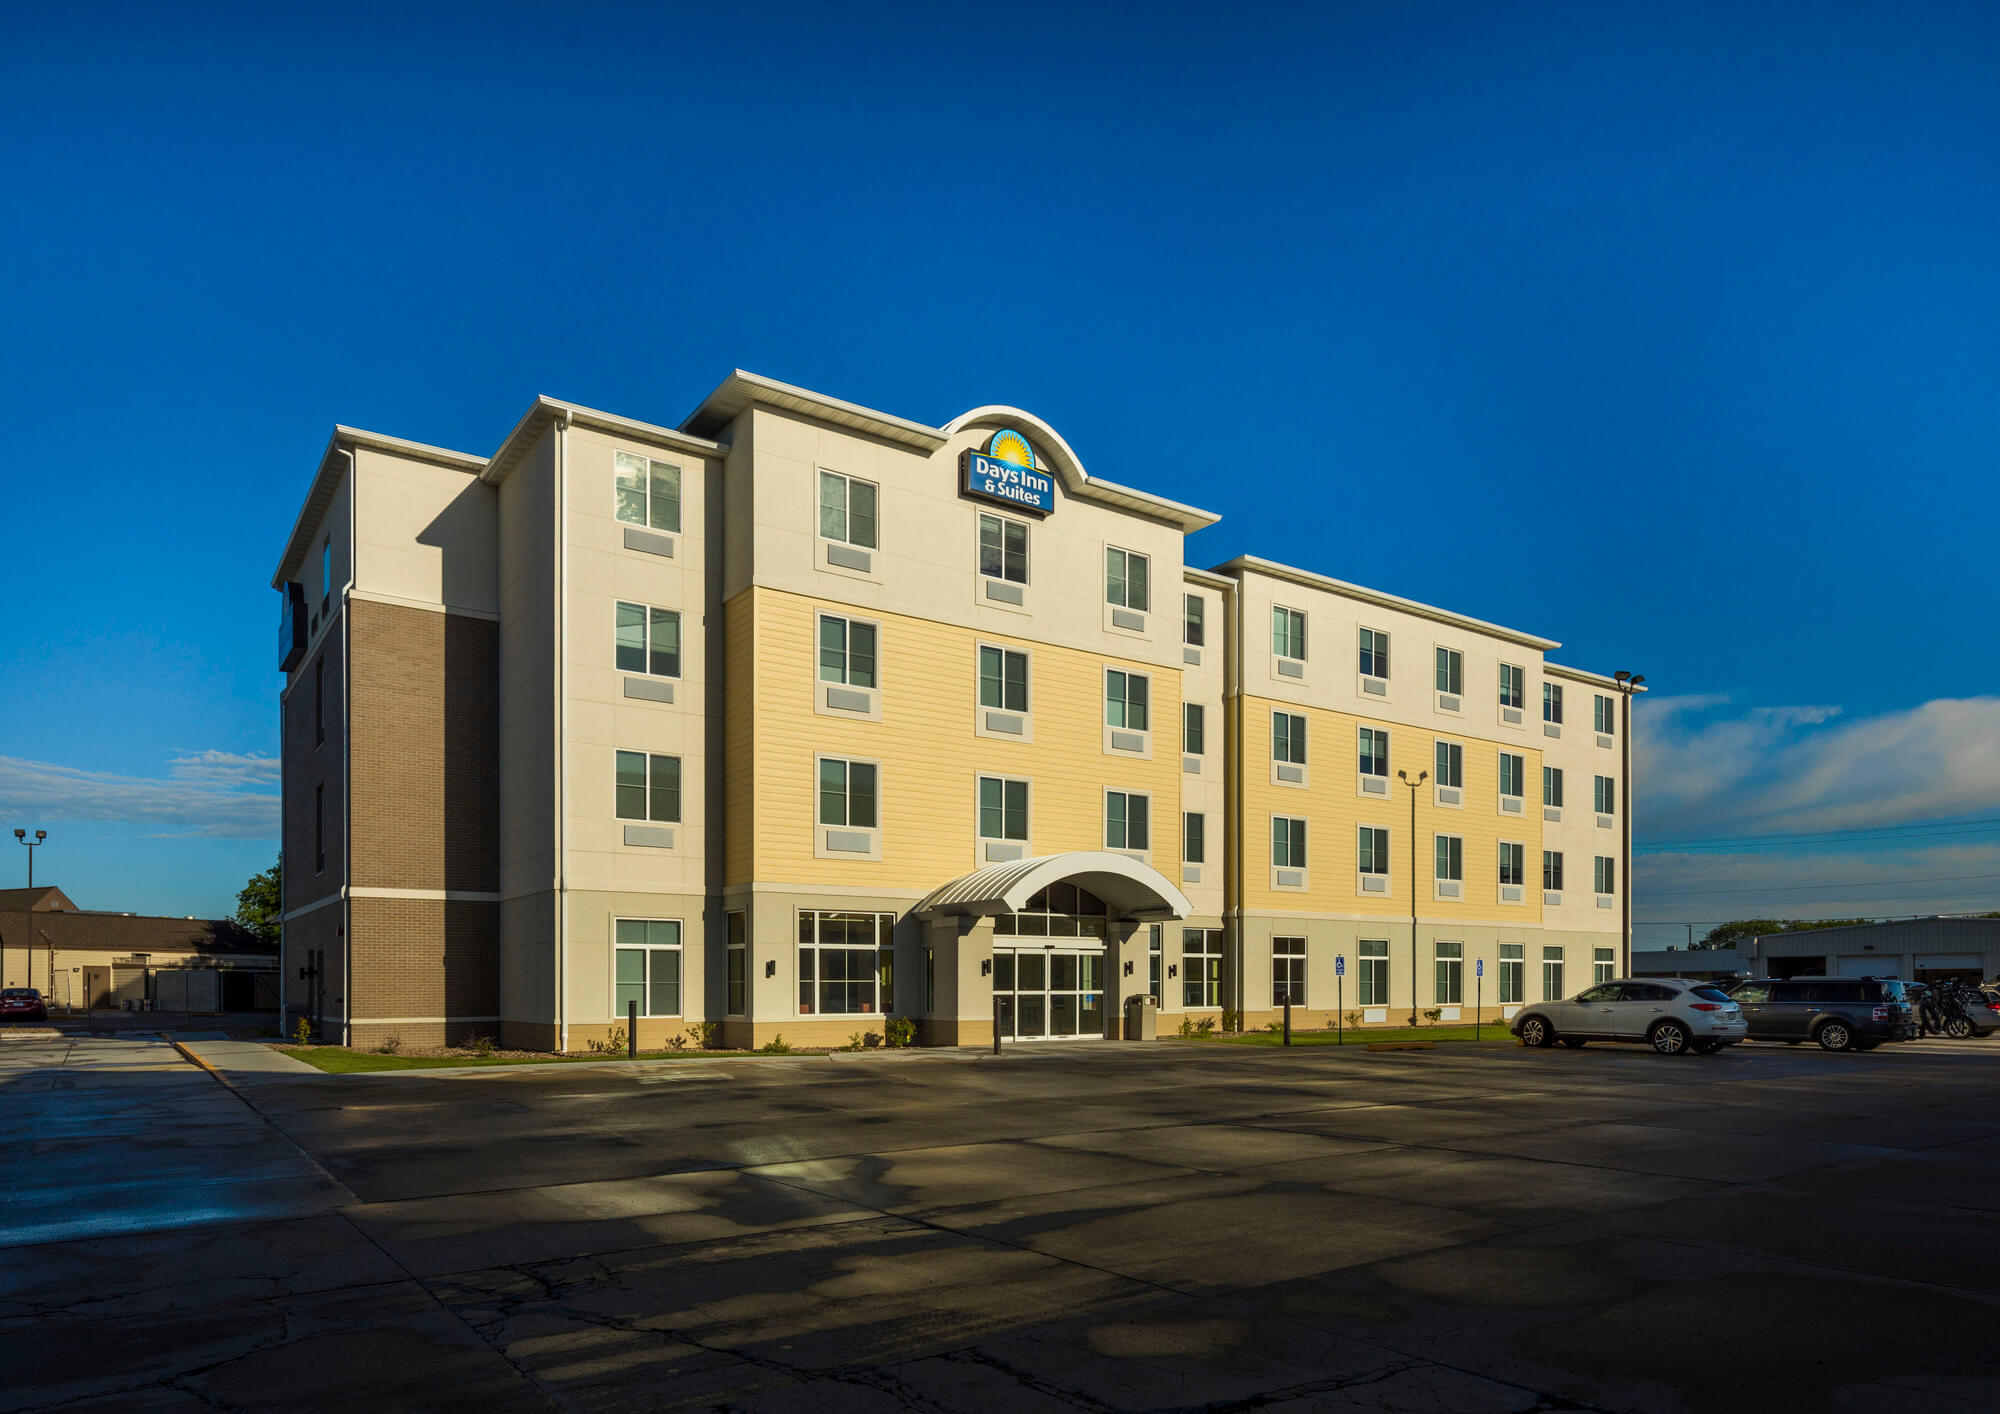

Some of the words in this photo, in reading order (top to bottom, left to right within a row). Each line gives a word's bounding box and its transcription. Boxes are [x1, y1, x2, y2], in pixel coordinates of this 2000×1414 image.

[976, 457, 1019, 483] Days
[1021, 470, 1048, 492] Inn
[984, 479, 995, 493] &
[997, 481, 1040, 505] Suites
